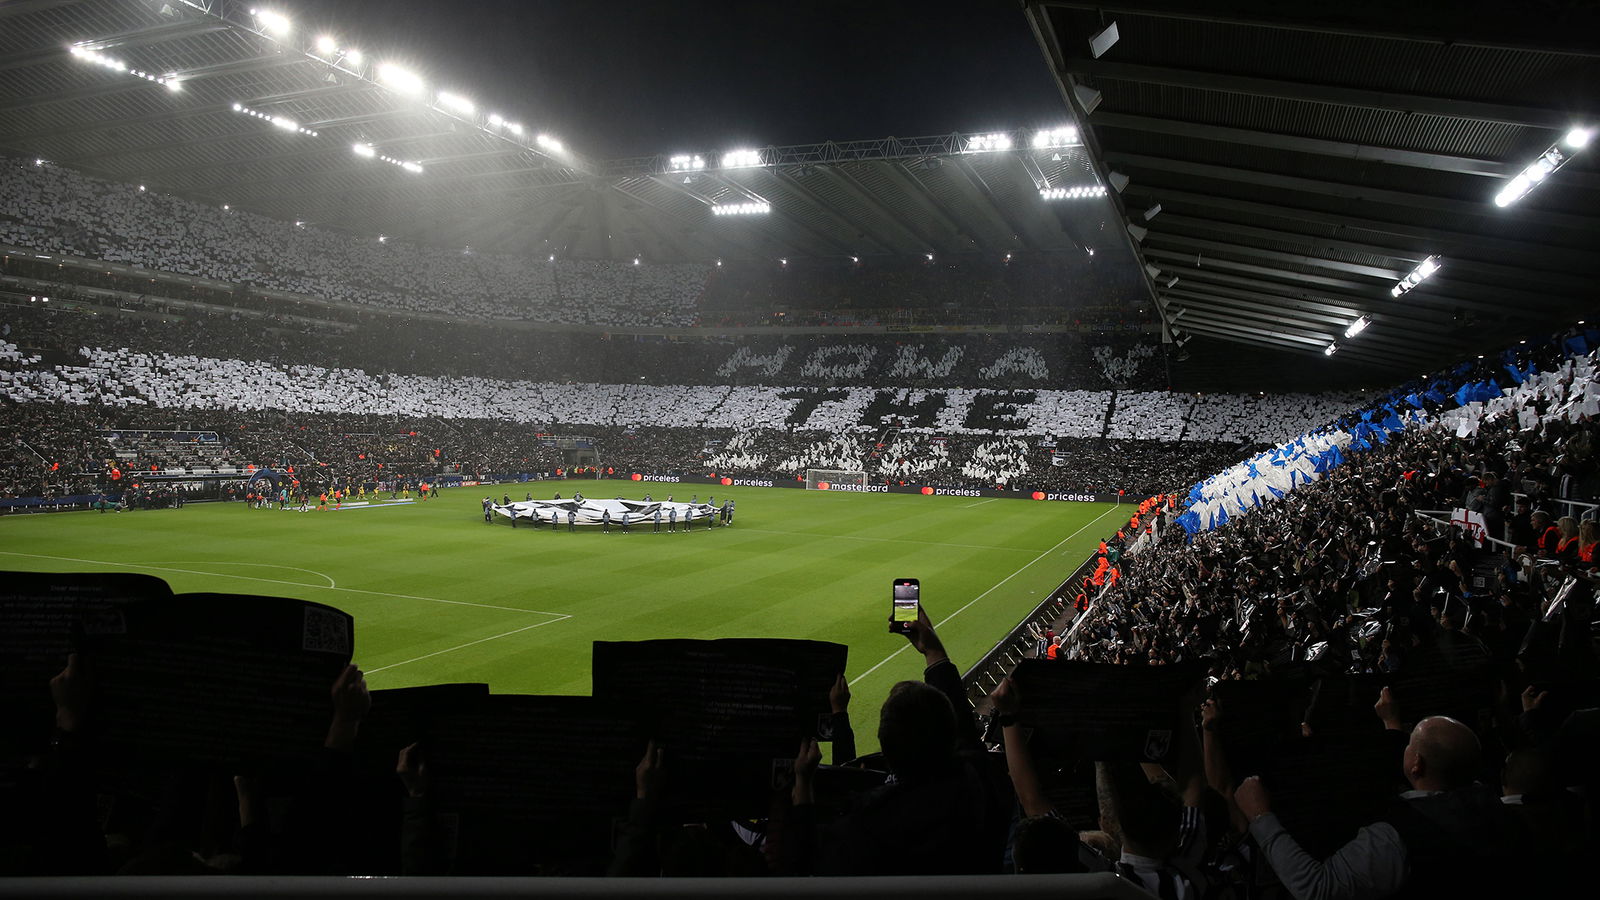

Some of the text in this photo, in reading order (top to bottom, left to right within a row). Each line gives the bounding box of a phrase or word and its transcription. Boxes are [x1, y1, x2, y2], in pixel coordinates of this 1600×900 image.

[777, 388, 1036, 431] THE
[643, 474, 680, 483] priceless
[733, 478, 773, 488] priceless
[831, 482, 888, 493] mastercard
[935, 487, 981, 498] priceless
[1047, 491, 1095, 503] priceless
